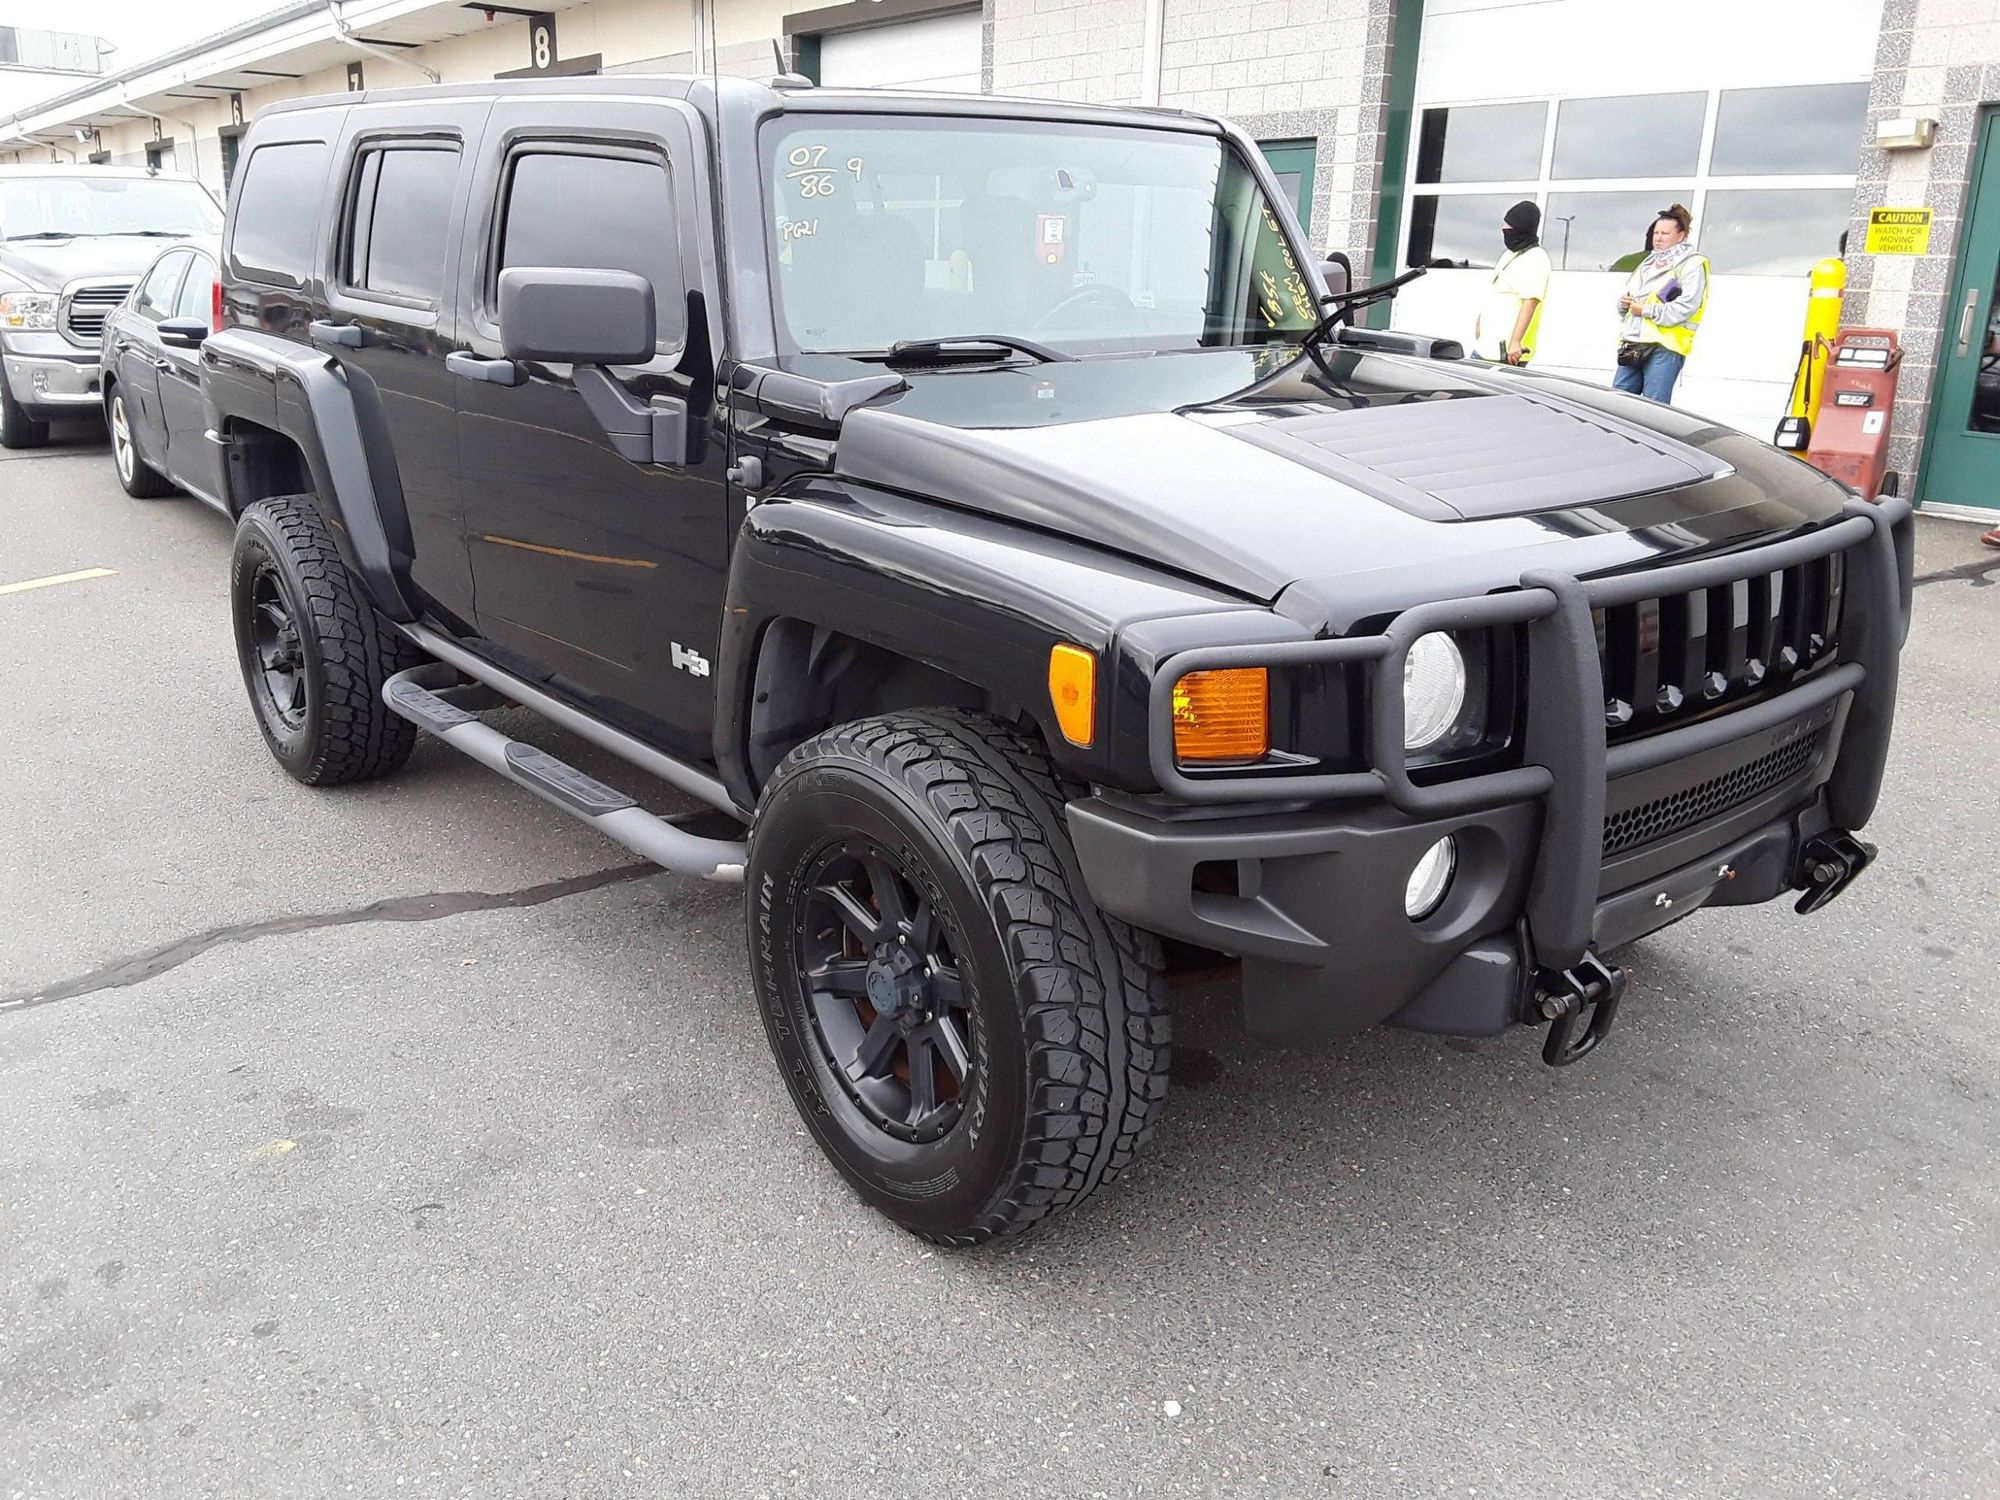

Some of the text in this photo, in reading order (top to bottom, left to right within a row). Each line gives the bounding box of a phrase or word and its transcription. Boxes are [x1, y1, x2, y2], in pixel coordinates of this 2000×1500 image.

[534, 26, 551, 69] 8
[232, 100, 241, 127] 6
[789, 145, 829, 168] 07
[800, 174, 835, 197] 86
[1878, 212, 1924, 223] CAUTION
[1875, 227, 1922, 235] WATCH FOR
[1878, 244, 1914, 252] VEHICLES
[670, 641, 710, 677] H3
[759, 871, 791, 1041] TERRAIN
